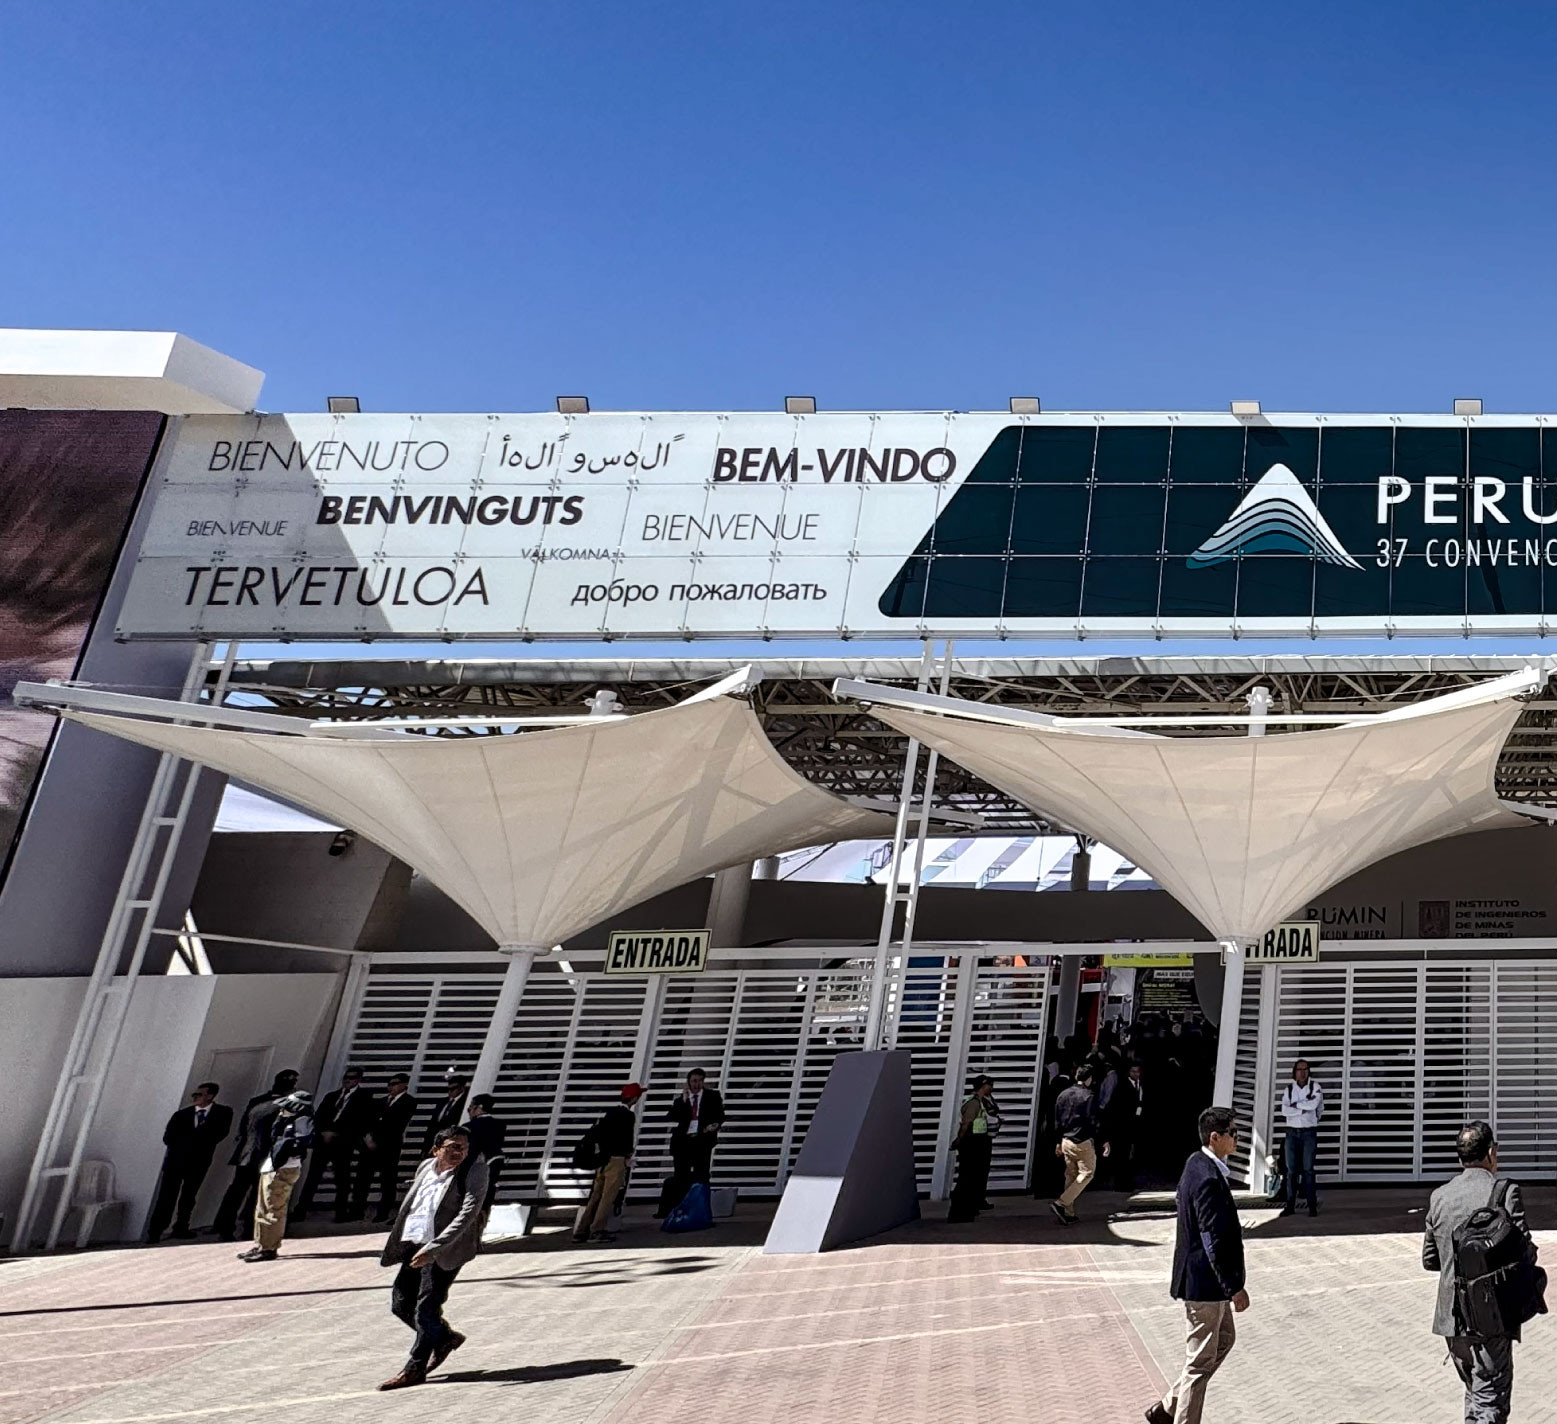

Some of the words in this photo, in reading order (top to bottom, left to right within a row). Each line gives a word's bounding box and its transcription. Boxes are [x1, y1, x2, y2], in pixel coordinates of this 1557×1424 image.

[208, 440, 449, 472] BIENVENUTO
[712, 447, 957, 483] BEM-VINDO
[316, 494, 585, 526] BENVINGUTS
[186, 520, 289, 537] BIENVENUE
[641, 513, 820, 541] BIENVENUE
[1376, 538, 1409, 568] 37
[184, 566, 490, 606] TERVETULOA
[571, 578, 659, 607] добро
[669, 582, 828, 602] пожаловать
[1455, 900, 1520, 908] INSTITUTO
[1475, 910, 1547, 918] INGENIEROS
[1455, 921, 1472, 929] DE
[1475, 921, 1515, 929] MINAS
[611, 936, 701, 968] ENTRADA
[1245, 928, 1313, 958] RADA
